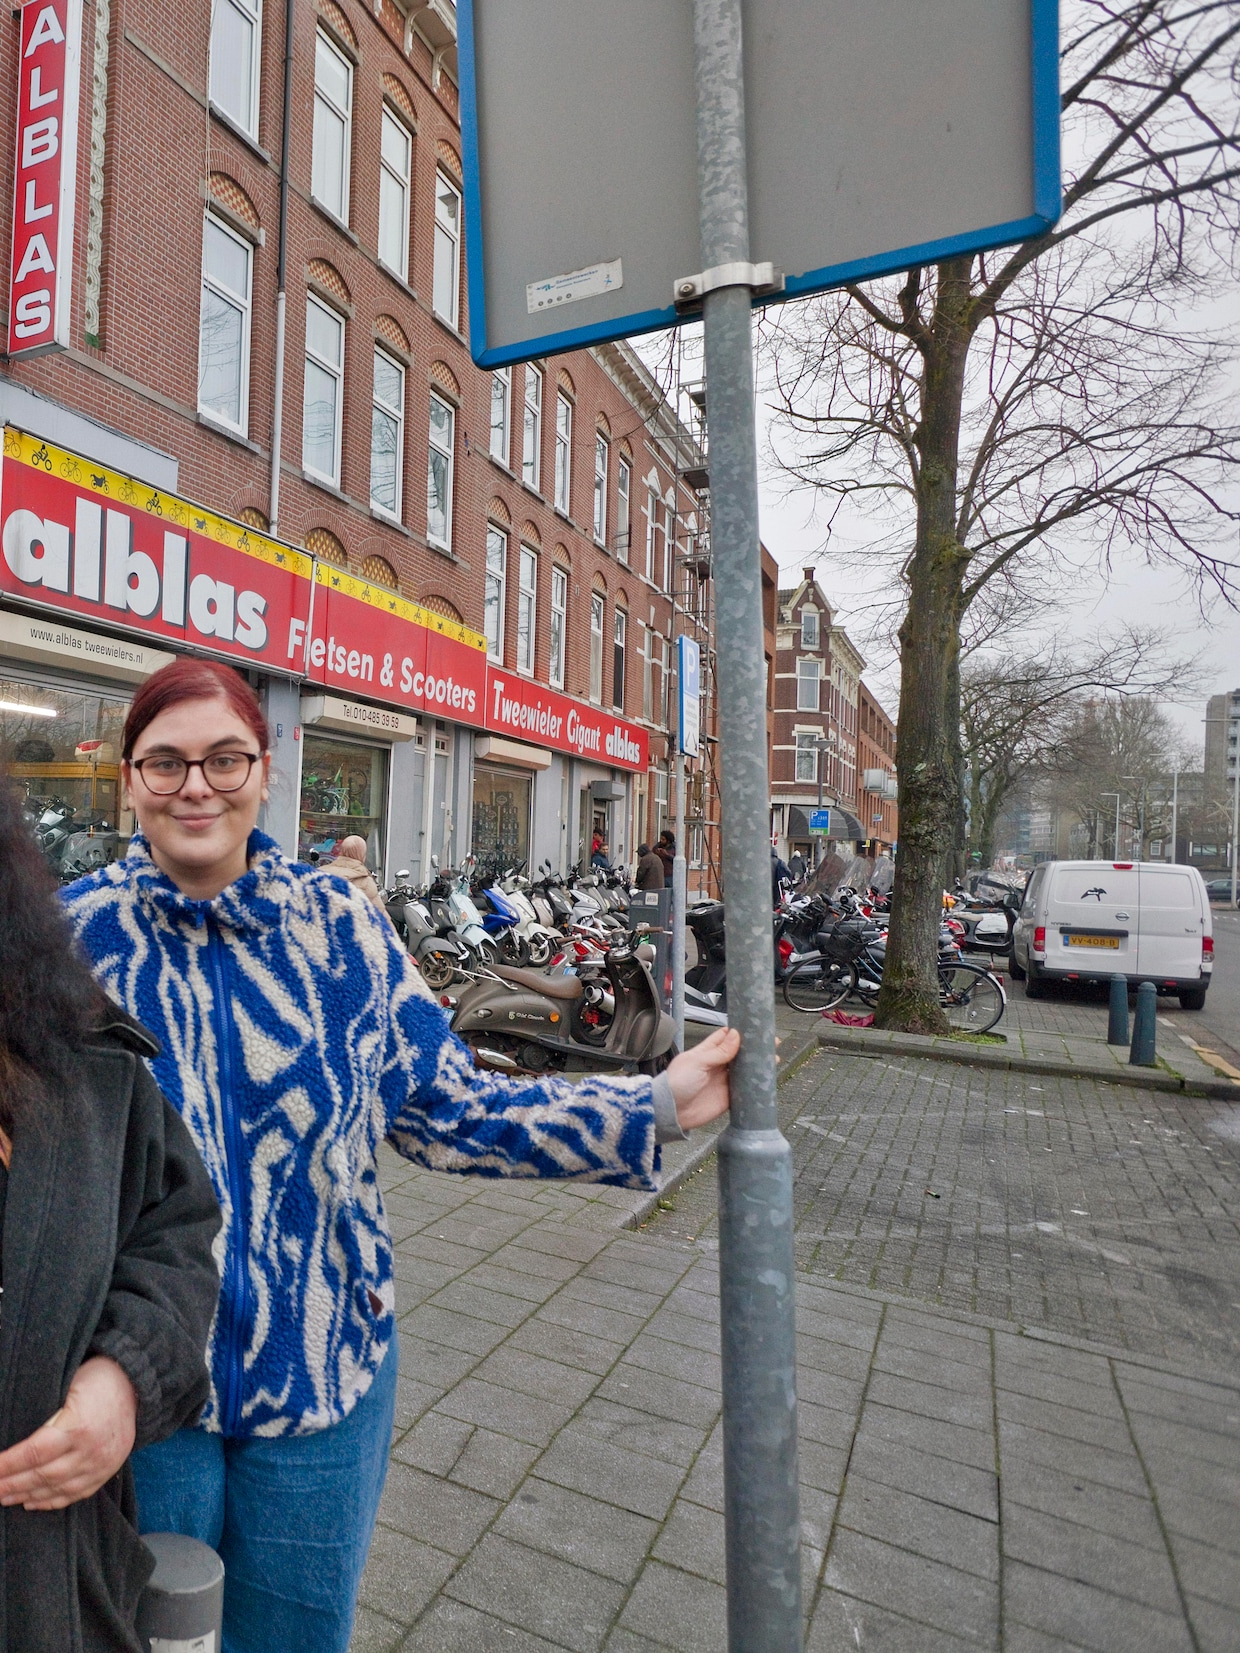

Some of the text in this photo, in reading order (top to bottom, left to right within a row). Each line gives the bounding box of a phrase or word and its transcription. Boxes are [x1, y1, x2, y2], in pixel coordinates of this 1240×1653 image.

[14, 4, 66, 339] ALBLAS
[2, 496, 270, 651] alblas
[30, 627, 143, 664] www.alblas tweewielers.nl
[686, 645, 696, 687] P
[380, 652, 394, 688] &
[400, 657, 476, 713] Scooters
[381, 714, 390, 727] 39
[391, 716, 400, 729] 59
[493, 679, 641, 764] Tweewieler Gigant alblas
